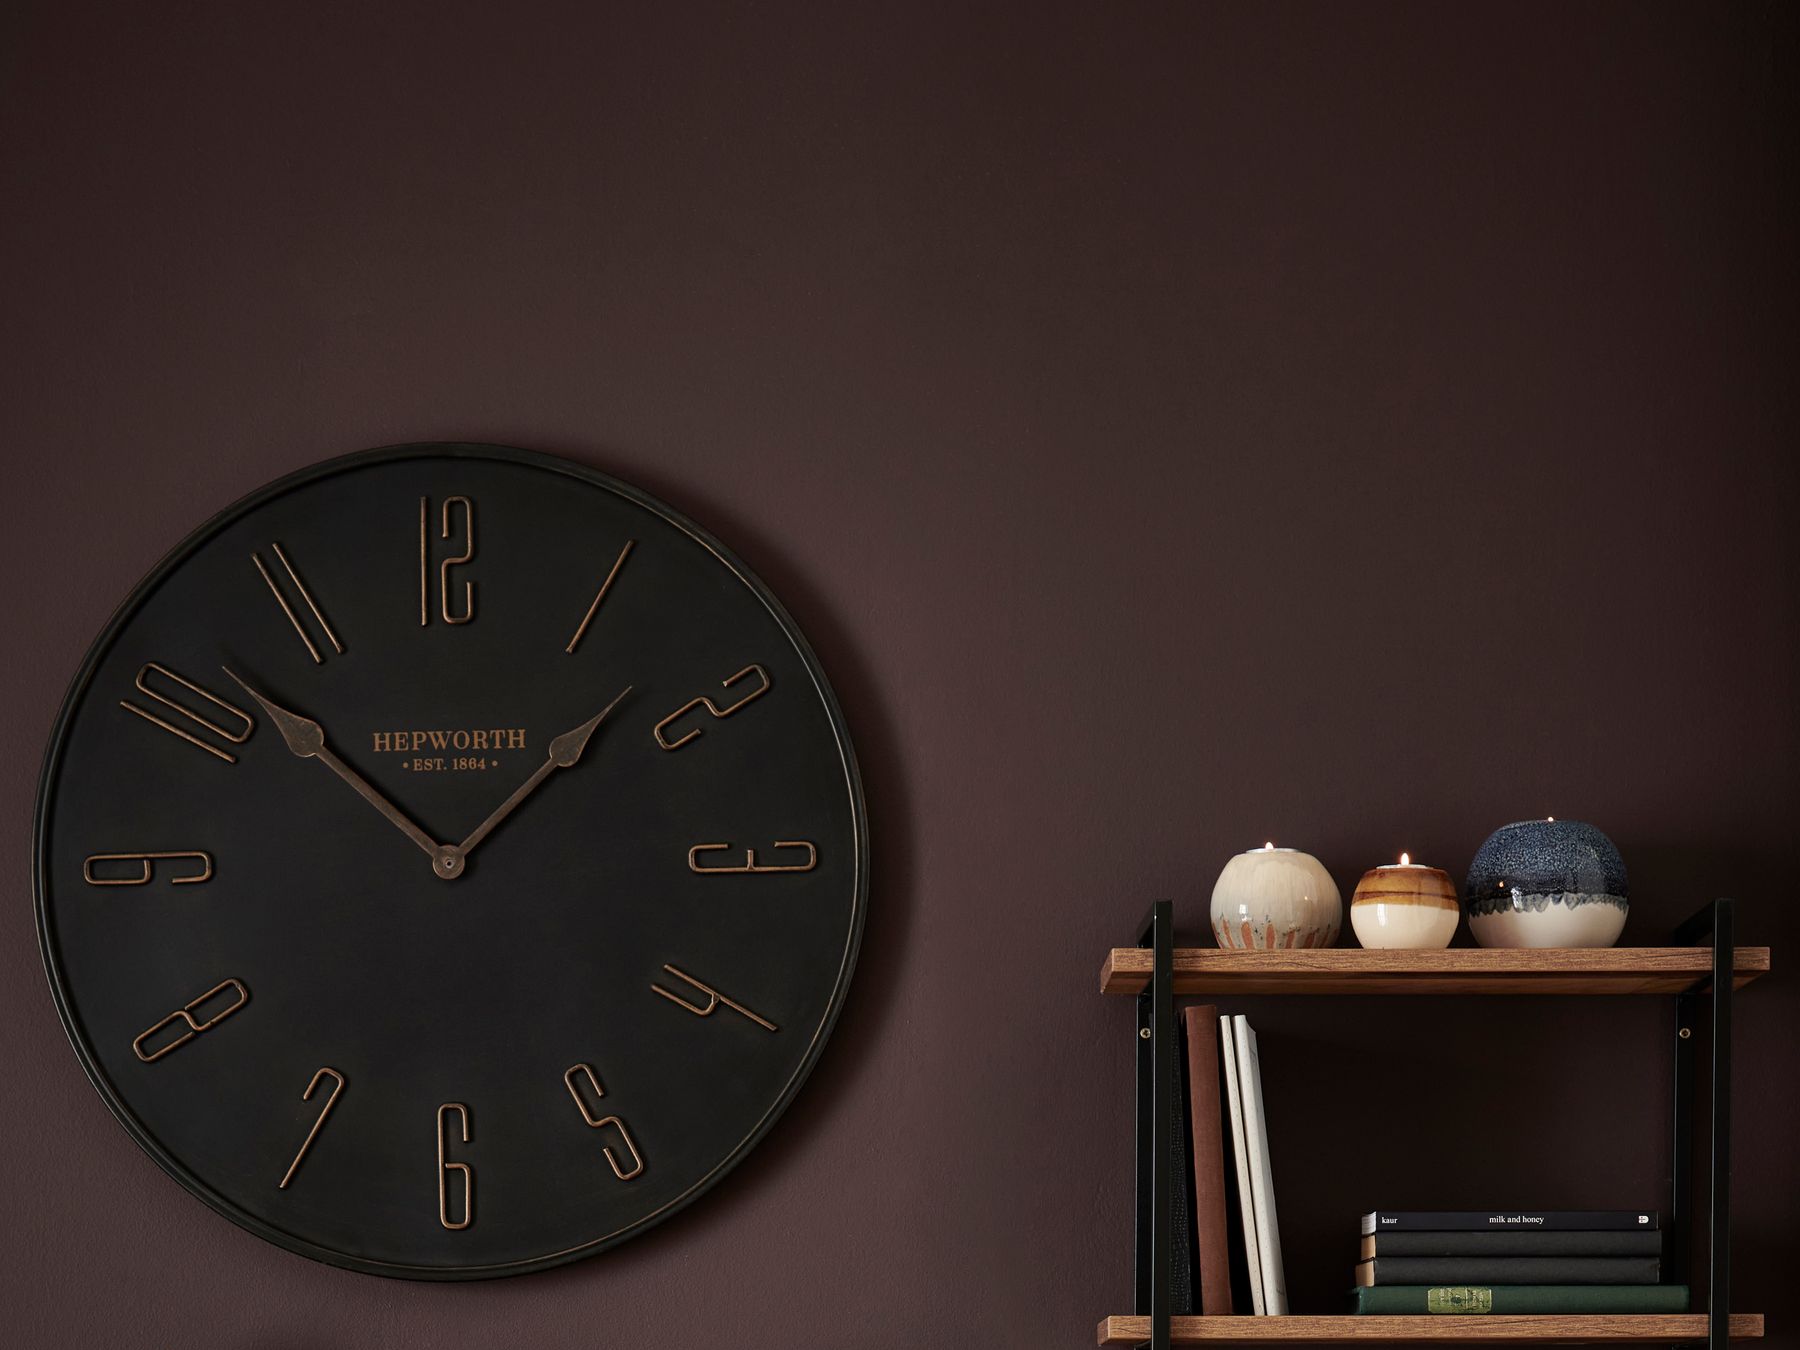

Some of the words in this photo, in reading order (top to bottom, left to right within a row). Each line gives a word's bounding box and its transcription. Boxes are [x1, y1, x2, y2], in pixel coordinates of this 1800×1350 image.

[251, 541, 346, 664] 11
[420, 495, 475, 627] 12
[565, 539, 636, 654] 1
[120, 662, 254, 764] 10
[373, 728, 527, 752] HEPWORTH
[653, 664, 772, 750] 2
[412, 758, 447, 771] EST.
[452, 757, 486, 770] 1864
[83, 850, 212, 886] 9
[688, 840, 817, 875] 3
[133, 977, 249, 1063] 8
[651, 963, 780, 1031] 4
[280, 1067, 346, 1190] 7
[564, 1062, 644, 1181] 5
[436, 1102, 473, 1230] 6
[1381, 1216, 1398, 1224] kaur
[1489, 1215, 1506, 1224] milk
[1507, 1215, 1520, 1224] and
[1522, 1215, 1545, 1226] honey
